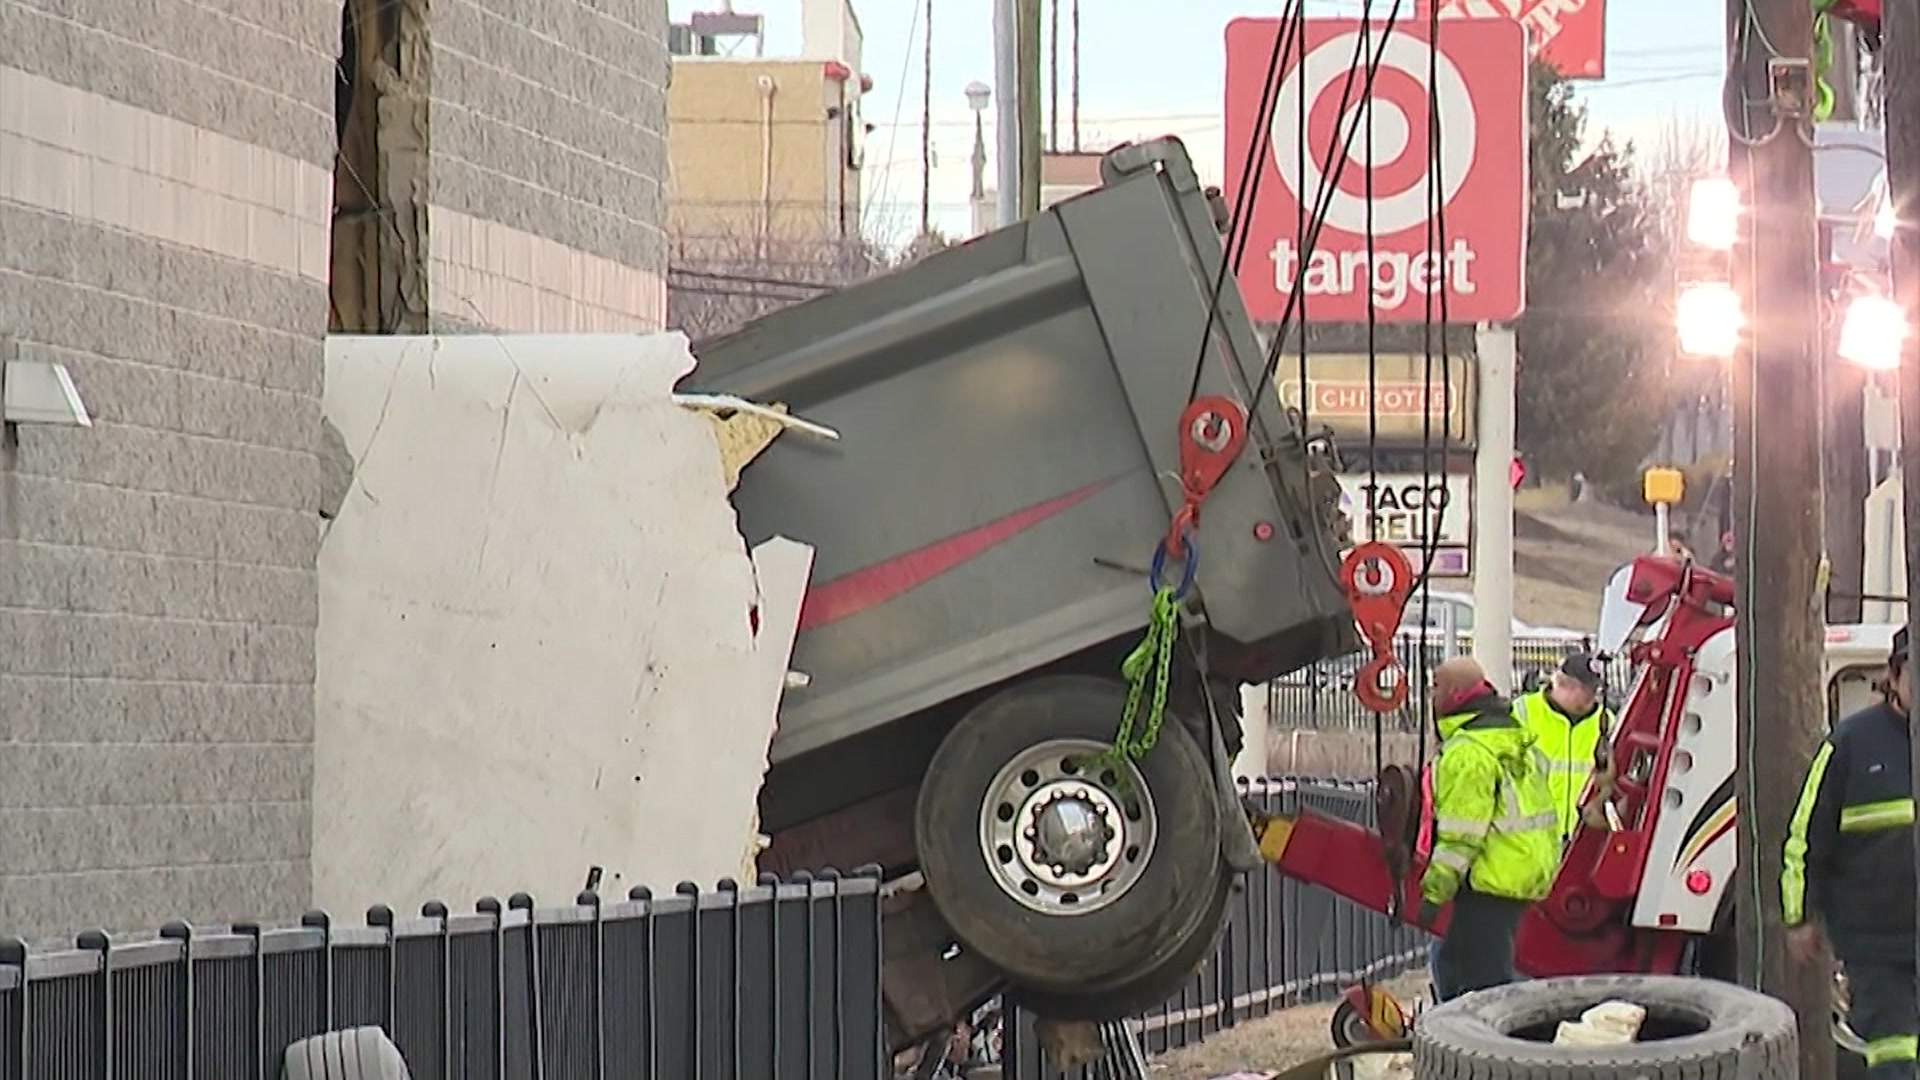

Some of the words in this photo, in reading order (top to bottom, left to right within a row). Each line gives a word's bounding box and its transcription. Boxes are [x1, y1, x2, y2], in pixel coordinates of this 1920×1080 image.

[1269, 238, 1476, 310] target
[1358, 485, 1451, 511] TACO
[1365, 512, 1449, 541] BELL
